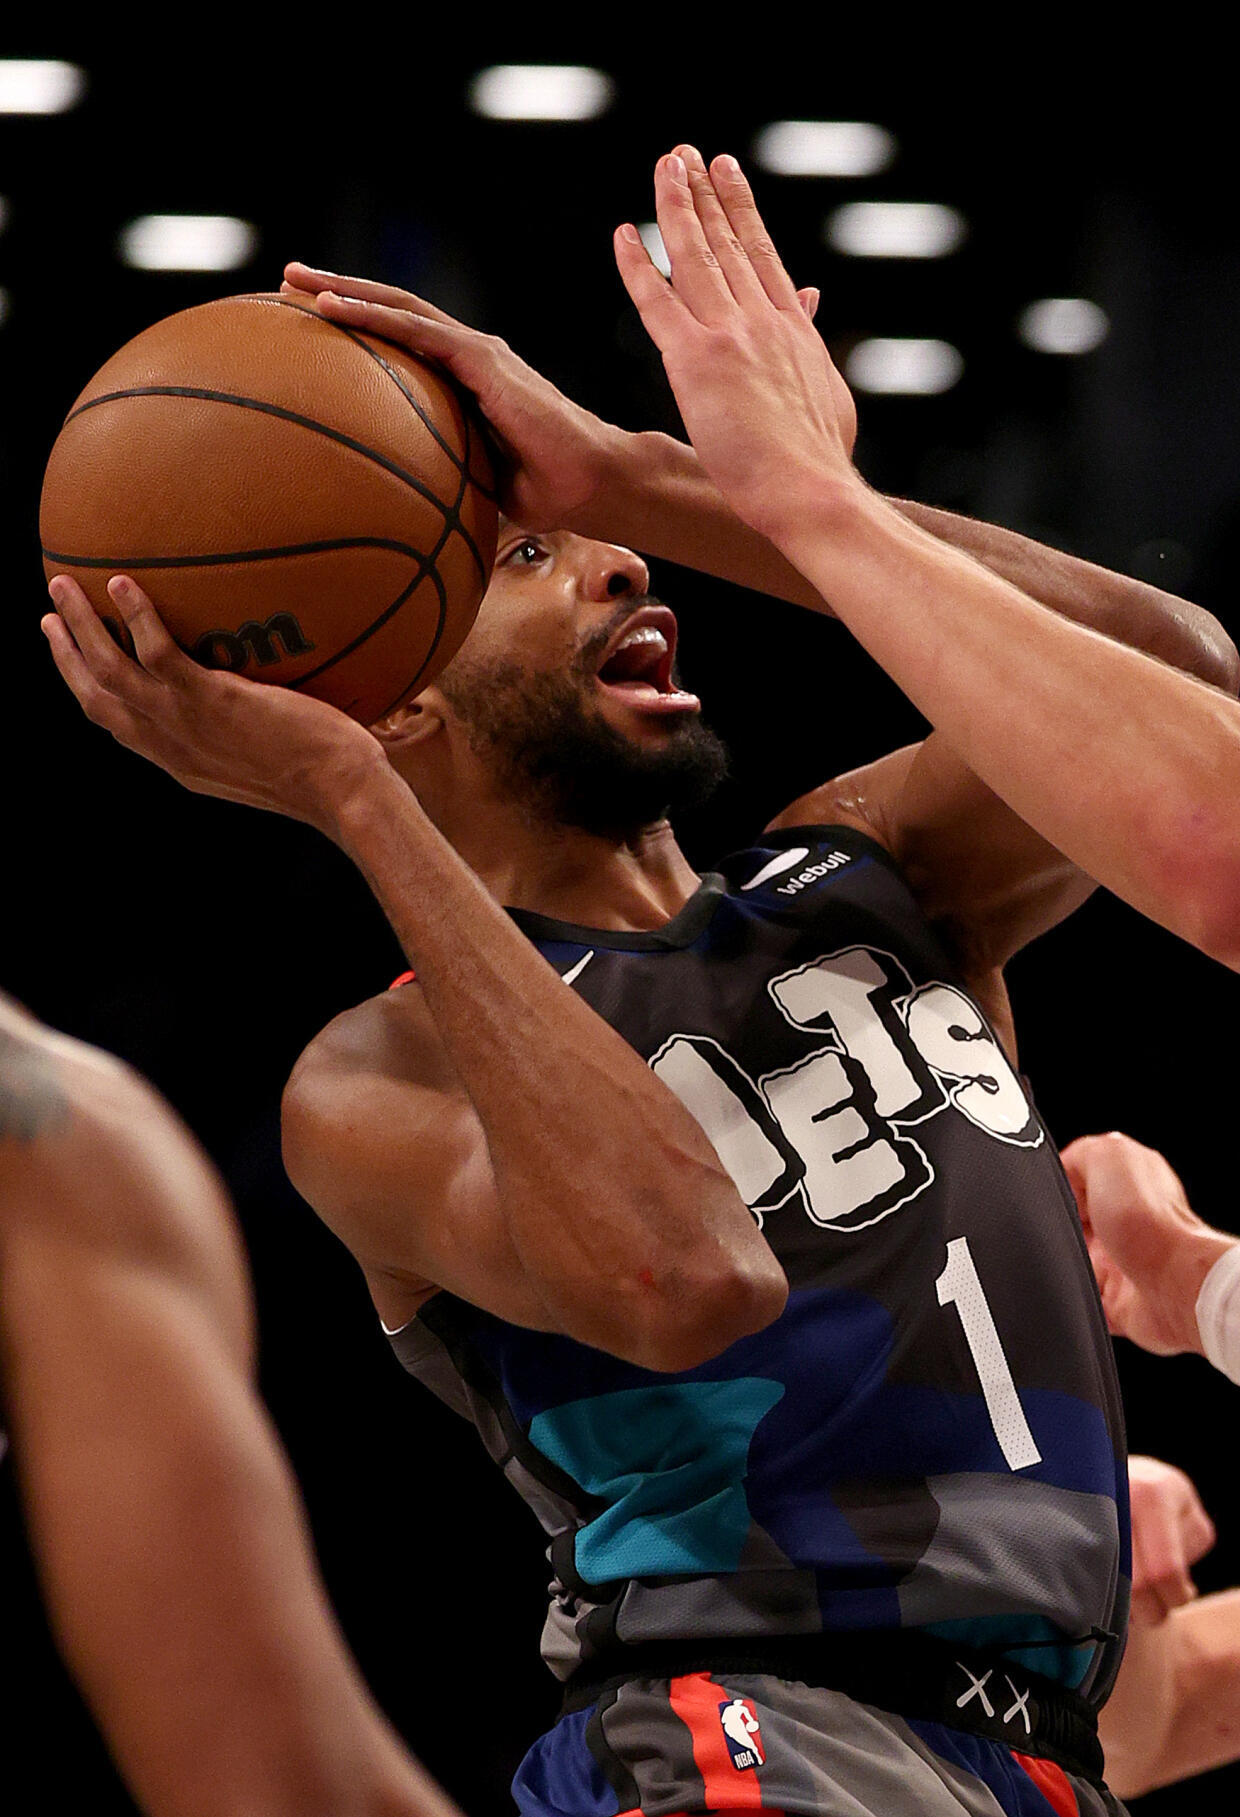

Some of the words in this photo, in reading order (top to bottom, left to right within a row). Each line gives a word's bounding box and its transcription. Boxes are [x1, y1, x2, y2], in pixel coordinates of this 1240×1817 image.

[776, 850, 852, 895] Webull
[935, 1236, 1042, 1471] 1
[733, 1750, 756, 1769] NBA
